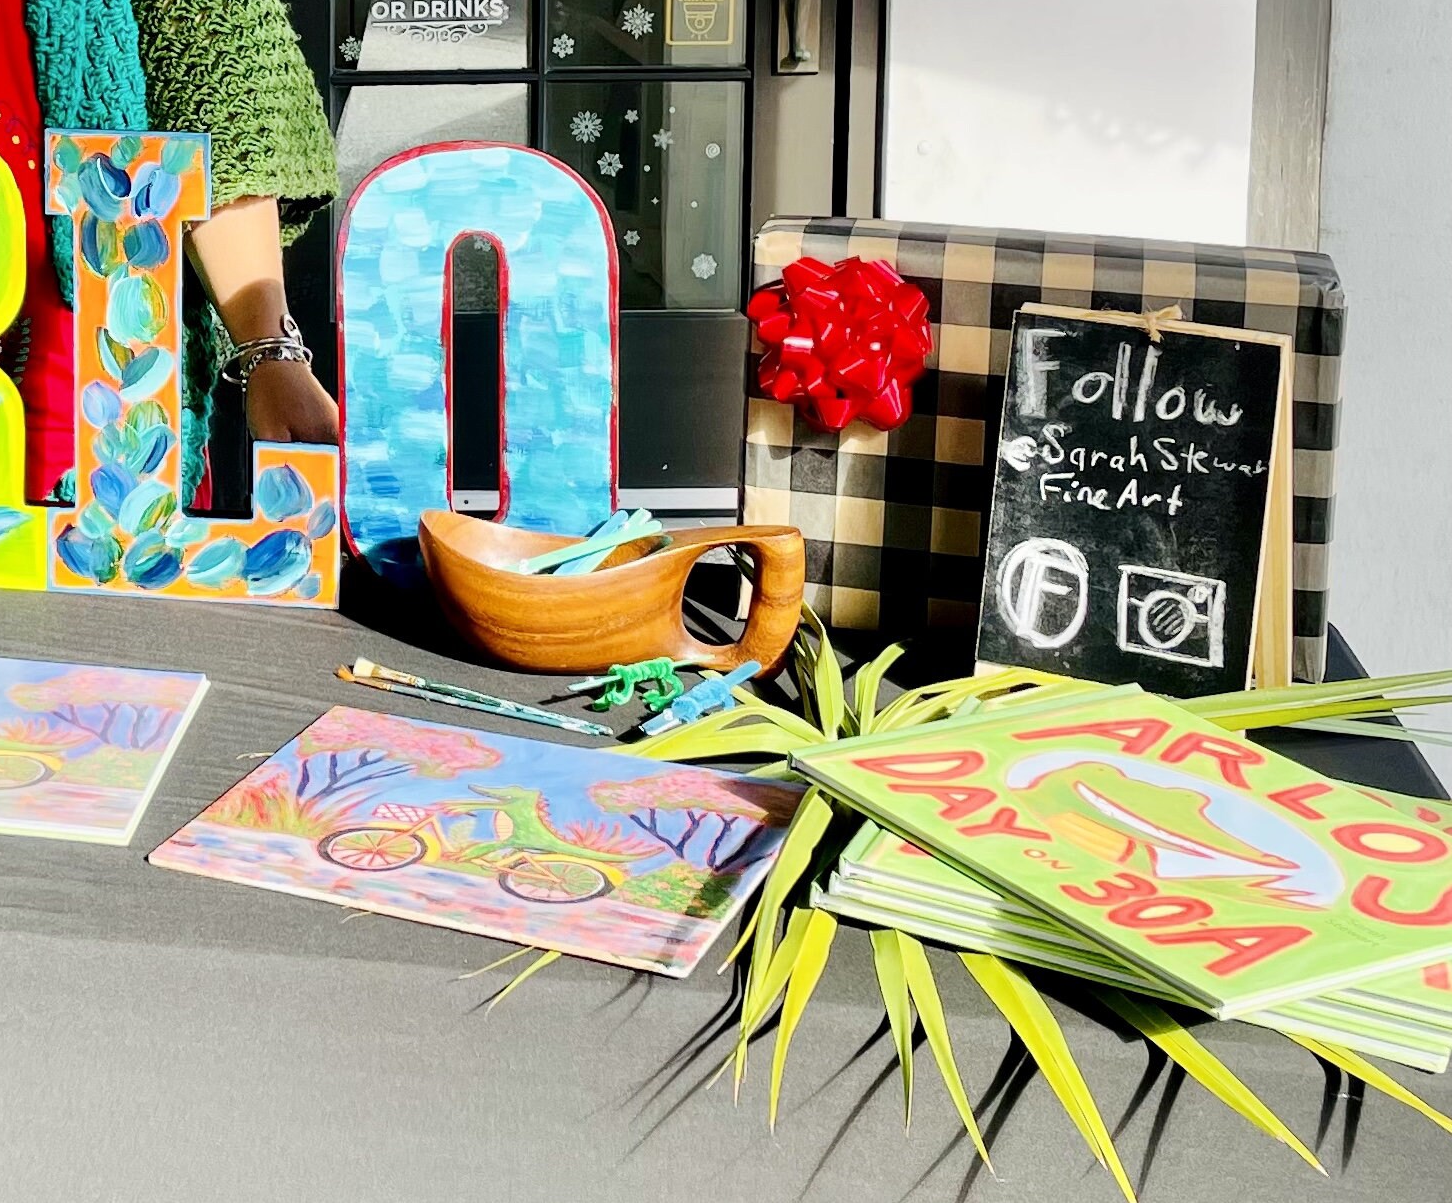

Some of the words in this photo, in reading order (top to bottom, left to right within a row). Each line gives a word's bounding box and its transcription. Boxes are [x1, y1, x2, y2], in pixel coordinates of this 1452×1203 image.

[371, 0, 407, 20] OR
[1014, 327, 1245, 428] Follow
[1039, 471, 1112, 511] Fine
[1115, 478, 1184, 517] Art
[851, 749, 1053, 843] DAY
